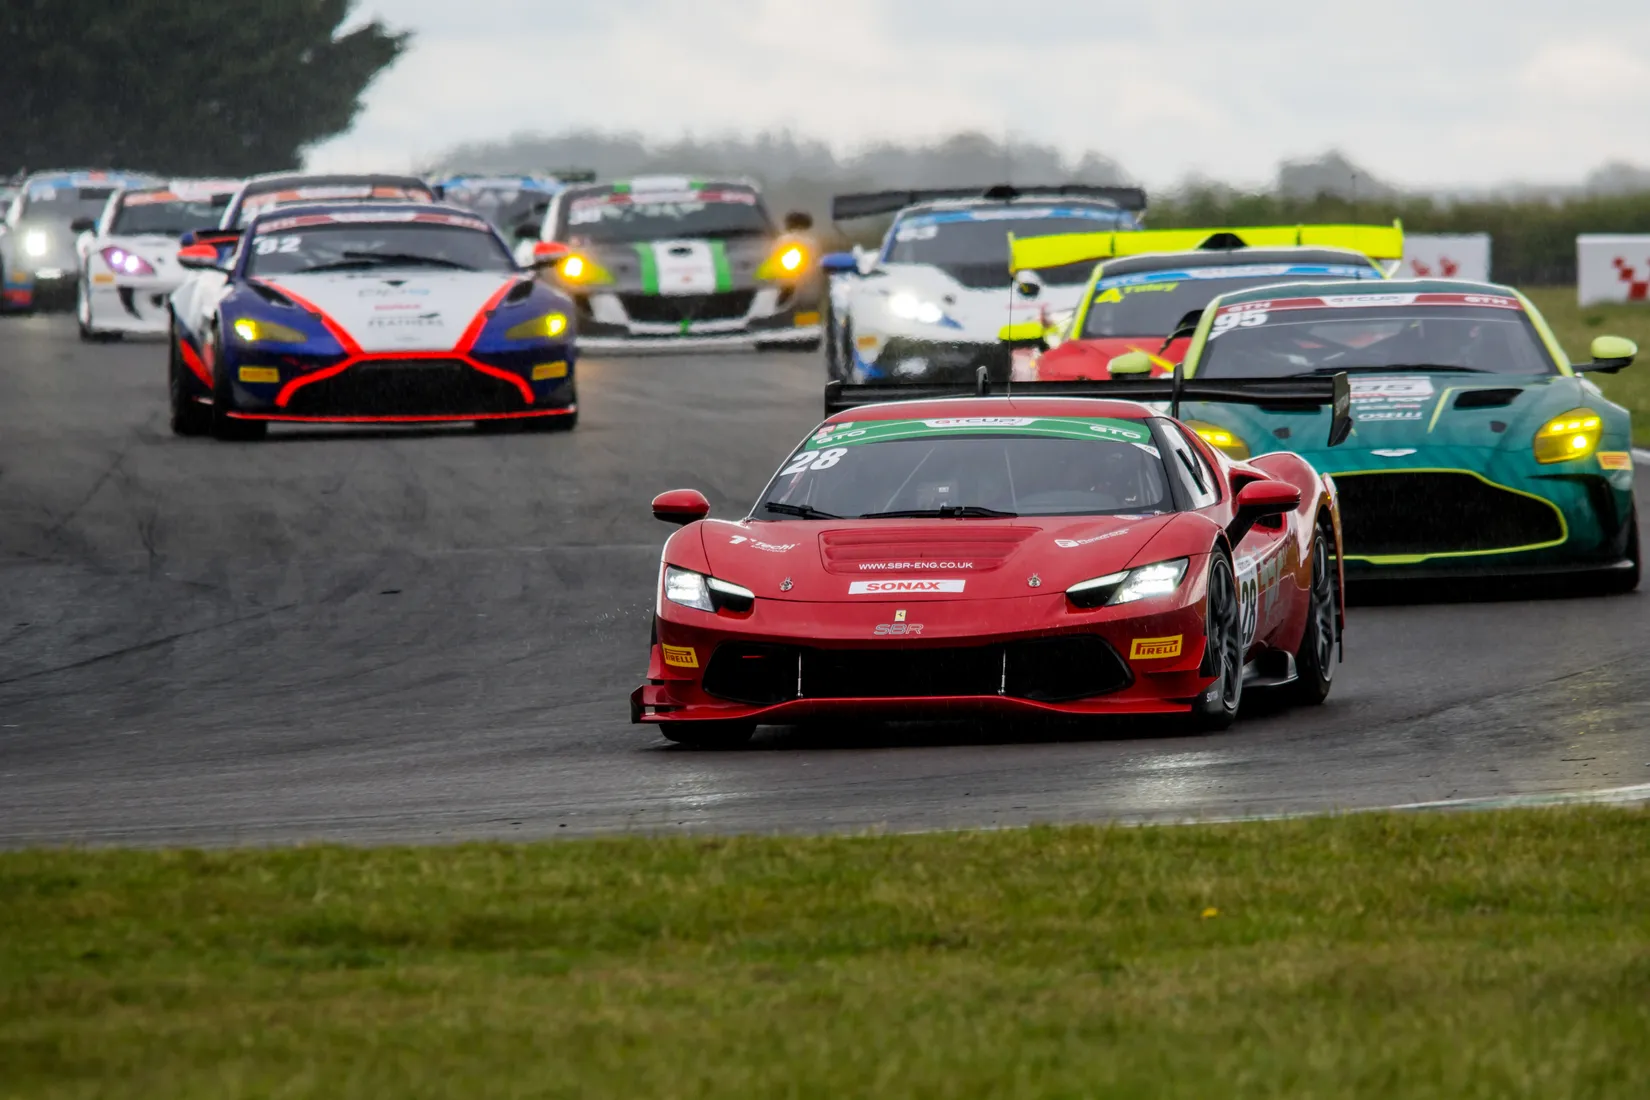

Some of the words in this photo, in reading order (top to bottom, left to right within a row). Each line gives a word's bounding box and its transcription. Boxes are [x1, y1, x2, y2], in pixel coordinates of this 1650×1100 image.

[1212, 309, 1268, 331] 95
[816, 429, 867, 444] GTO
[1089, 425, 1142, 439] GTO
[780, 448, 849, 477] 28
[858, 561, 973, 571] WWW.SBR-ENG.CO.UK
[866, 581, 942, 592] SONAX
[1241, 578, 1257, 646] 28
[873, 623, 924, 636] SBR
[664, 647, 695, 664] PIRELLI
[1134, 639, 1179, 656] PIRELLI
